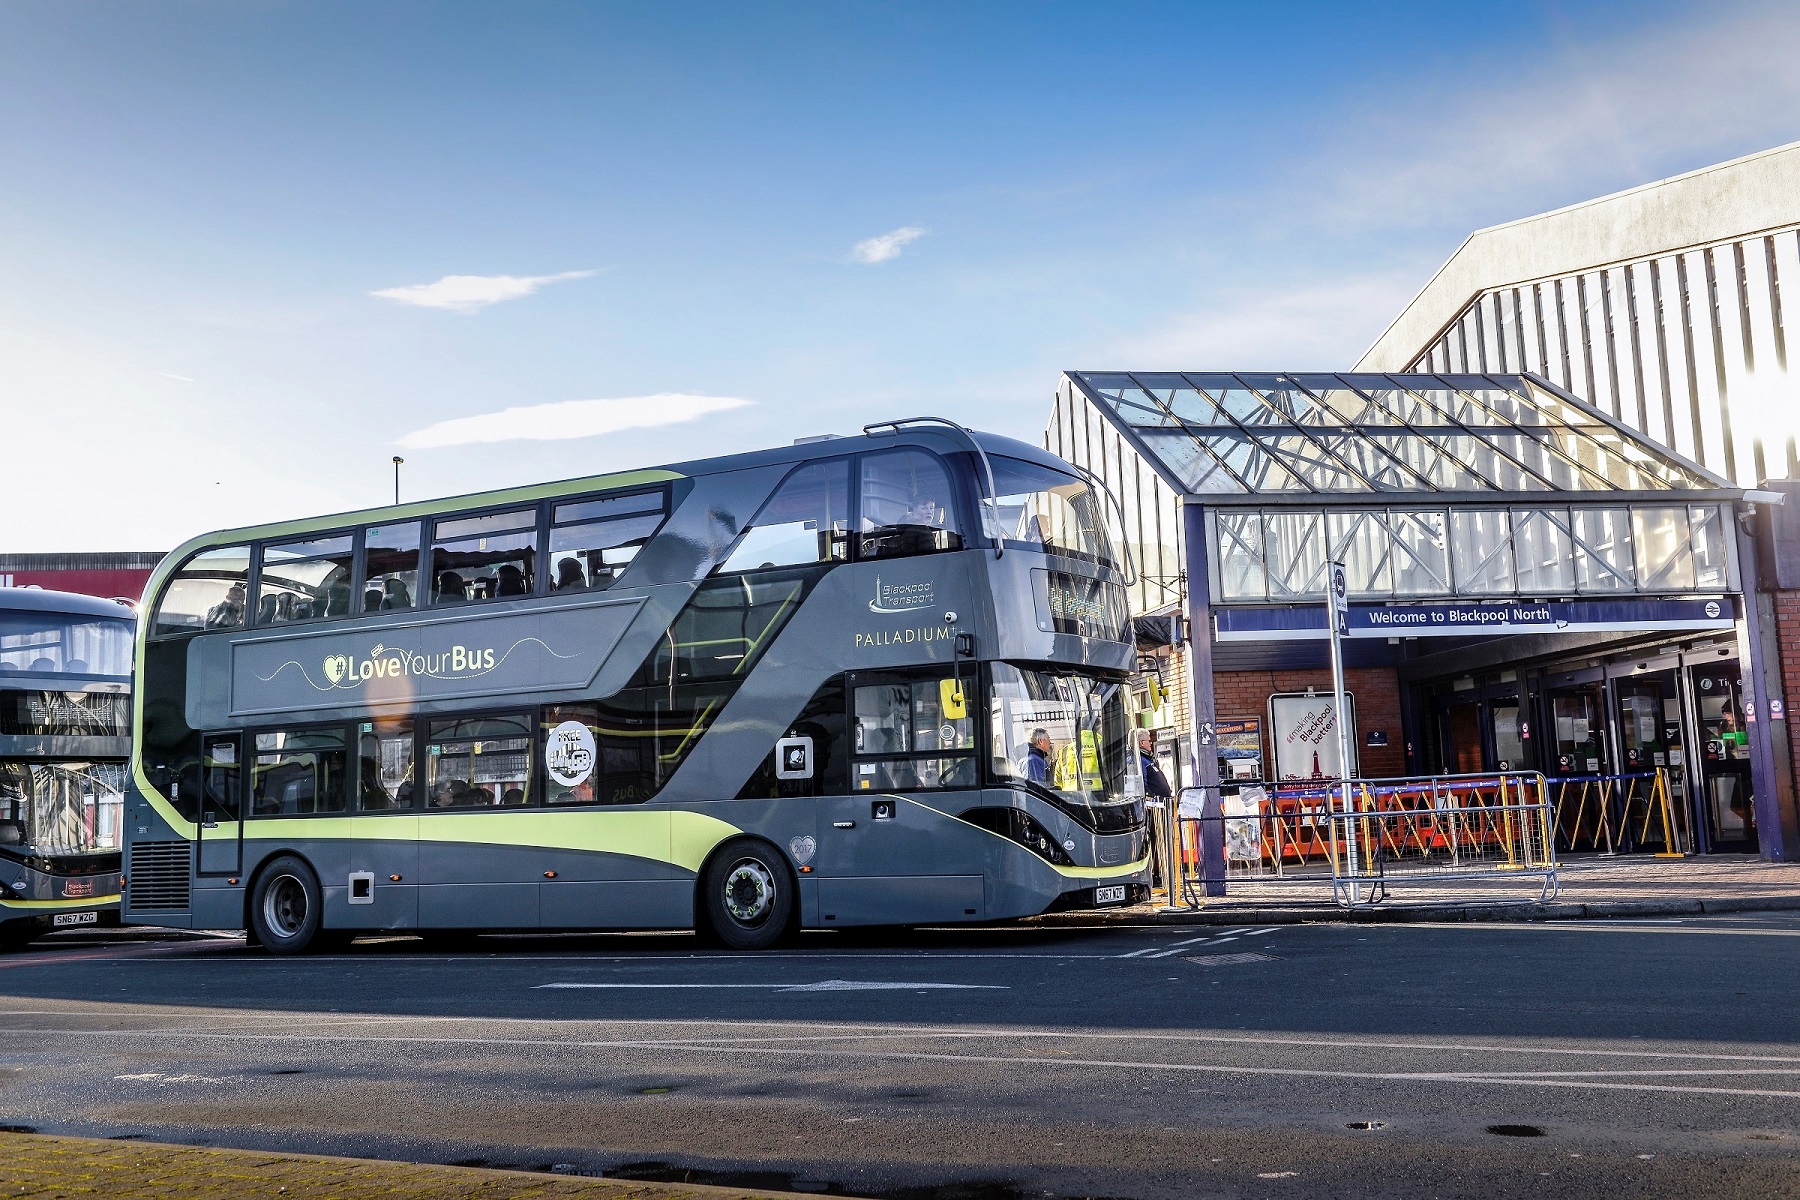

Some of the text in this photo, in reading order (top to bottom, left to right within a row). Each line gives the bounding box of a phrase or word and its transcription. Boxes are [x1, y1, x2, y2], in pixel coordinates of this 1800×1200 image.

[883, 580, 934, 596] Blackpool
[882, 592, 935, 606] Transport
[1340, 613, 1346, 630] A
[1369, 607, 1550, 624] Welcome to Blackpool North
[855, 626, 950, 648] PALLADIUM
[1300, 703, 1333, 743] Blackpool
[558, 729, 581, 742] FREE
[794, 844, 812, 854] 2017
[57, 913, 94, 924] SN67 WZG
